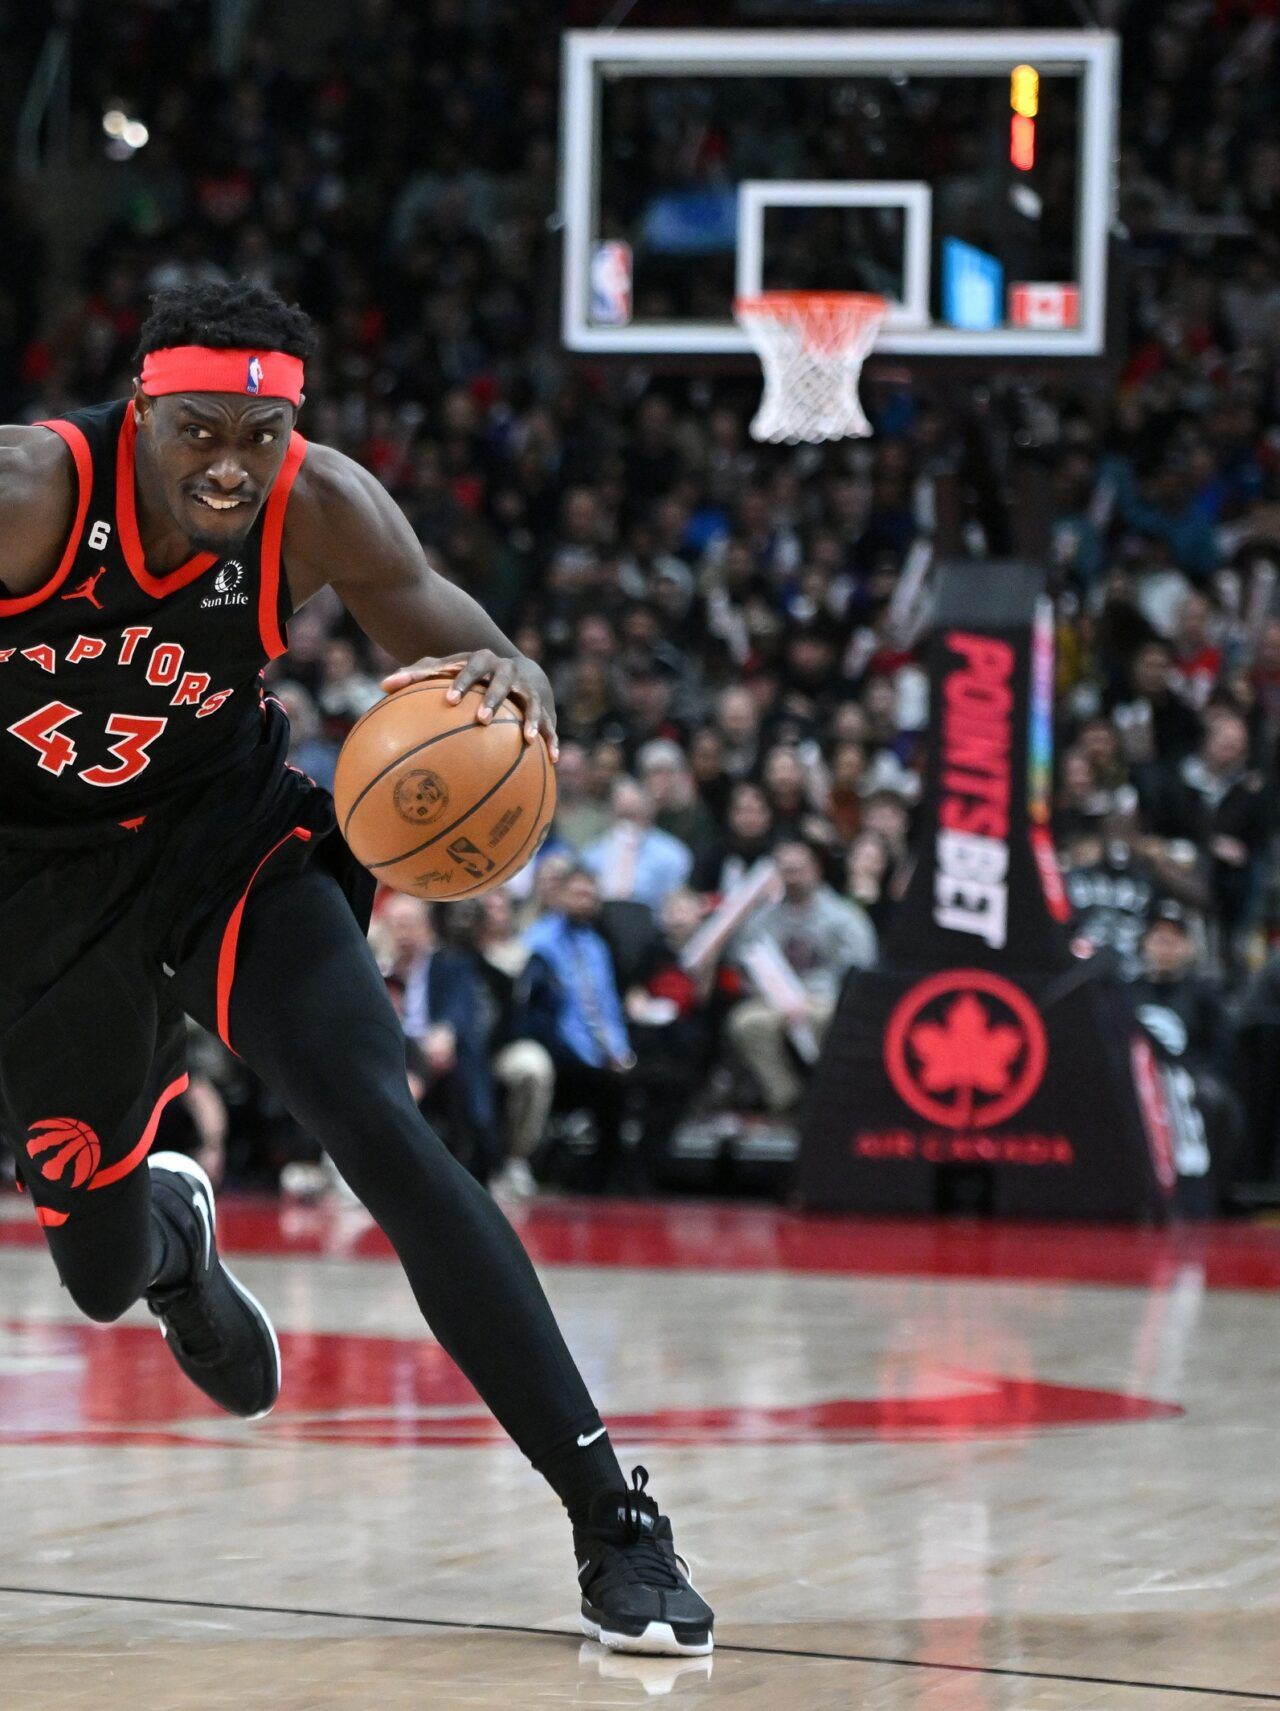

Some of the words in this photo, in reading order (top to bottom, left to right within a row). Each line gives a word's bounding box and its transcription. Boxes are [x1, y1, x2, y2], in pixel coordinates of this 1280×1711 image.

[88, 520, 111, 551] 6
[200, 597, 222, 609] Sun
[224, 592, 249, 605] Life
[7, 700, 169, 788] 43
